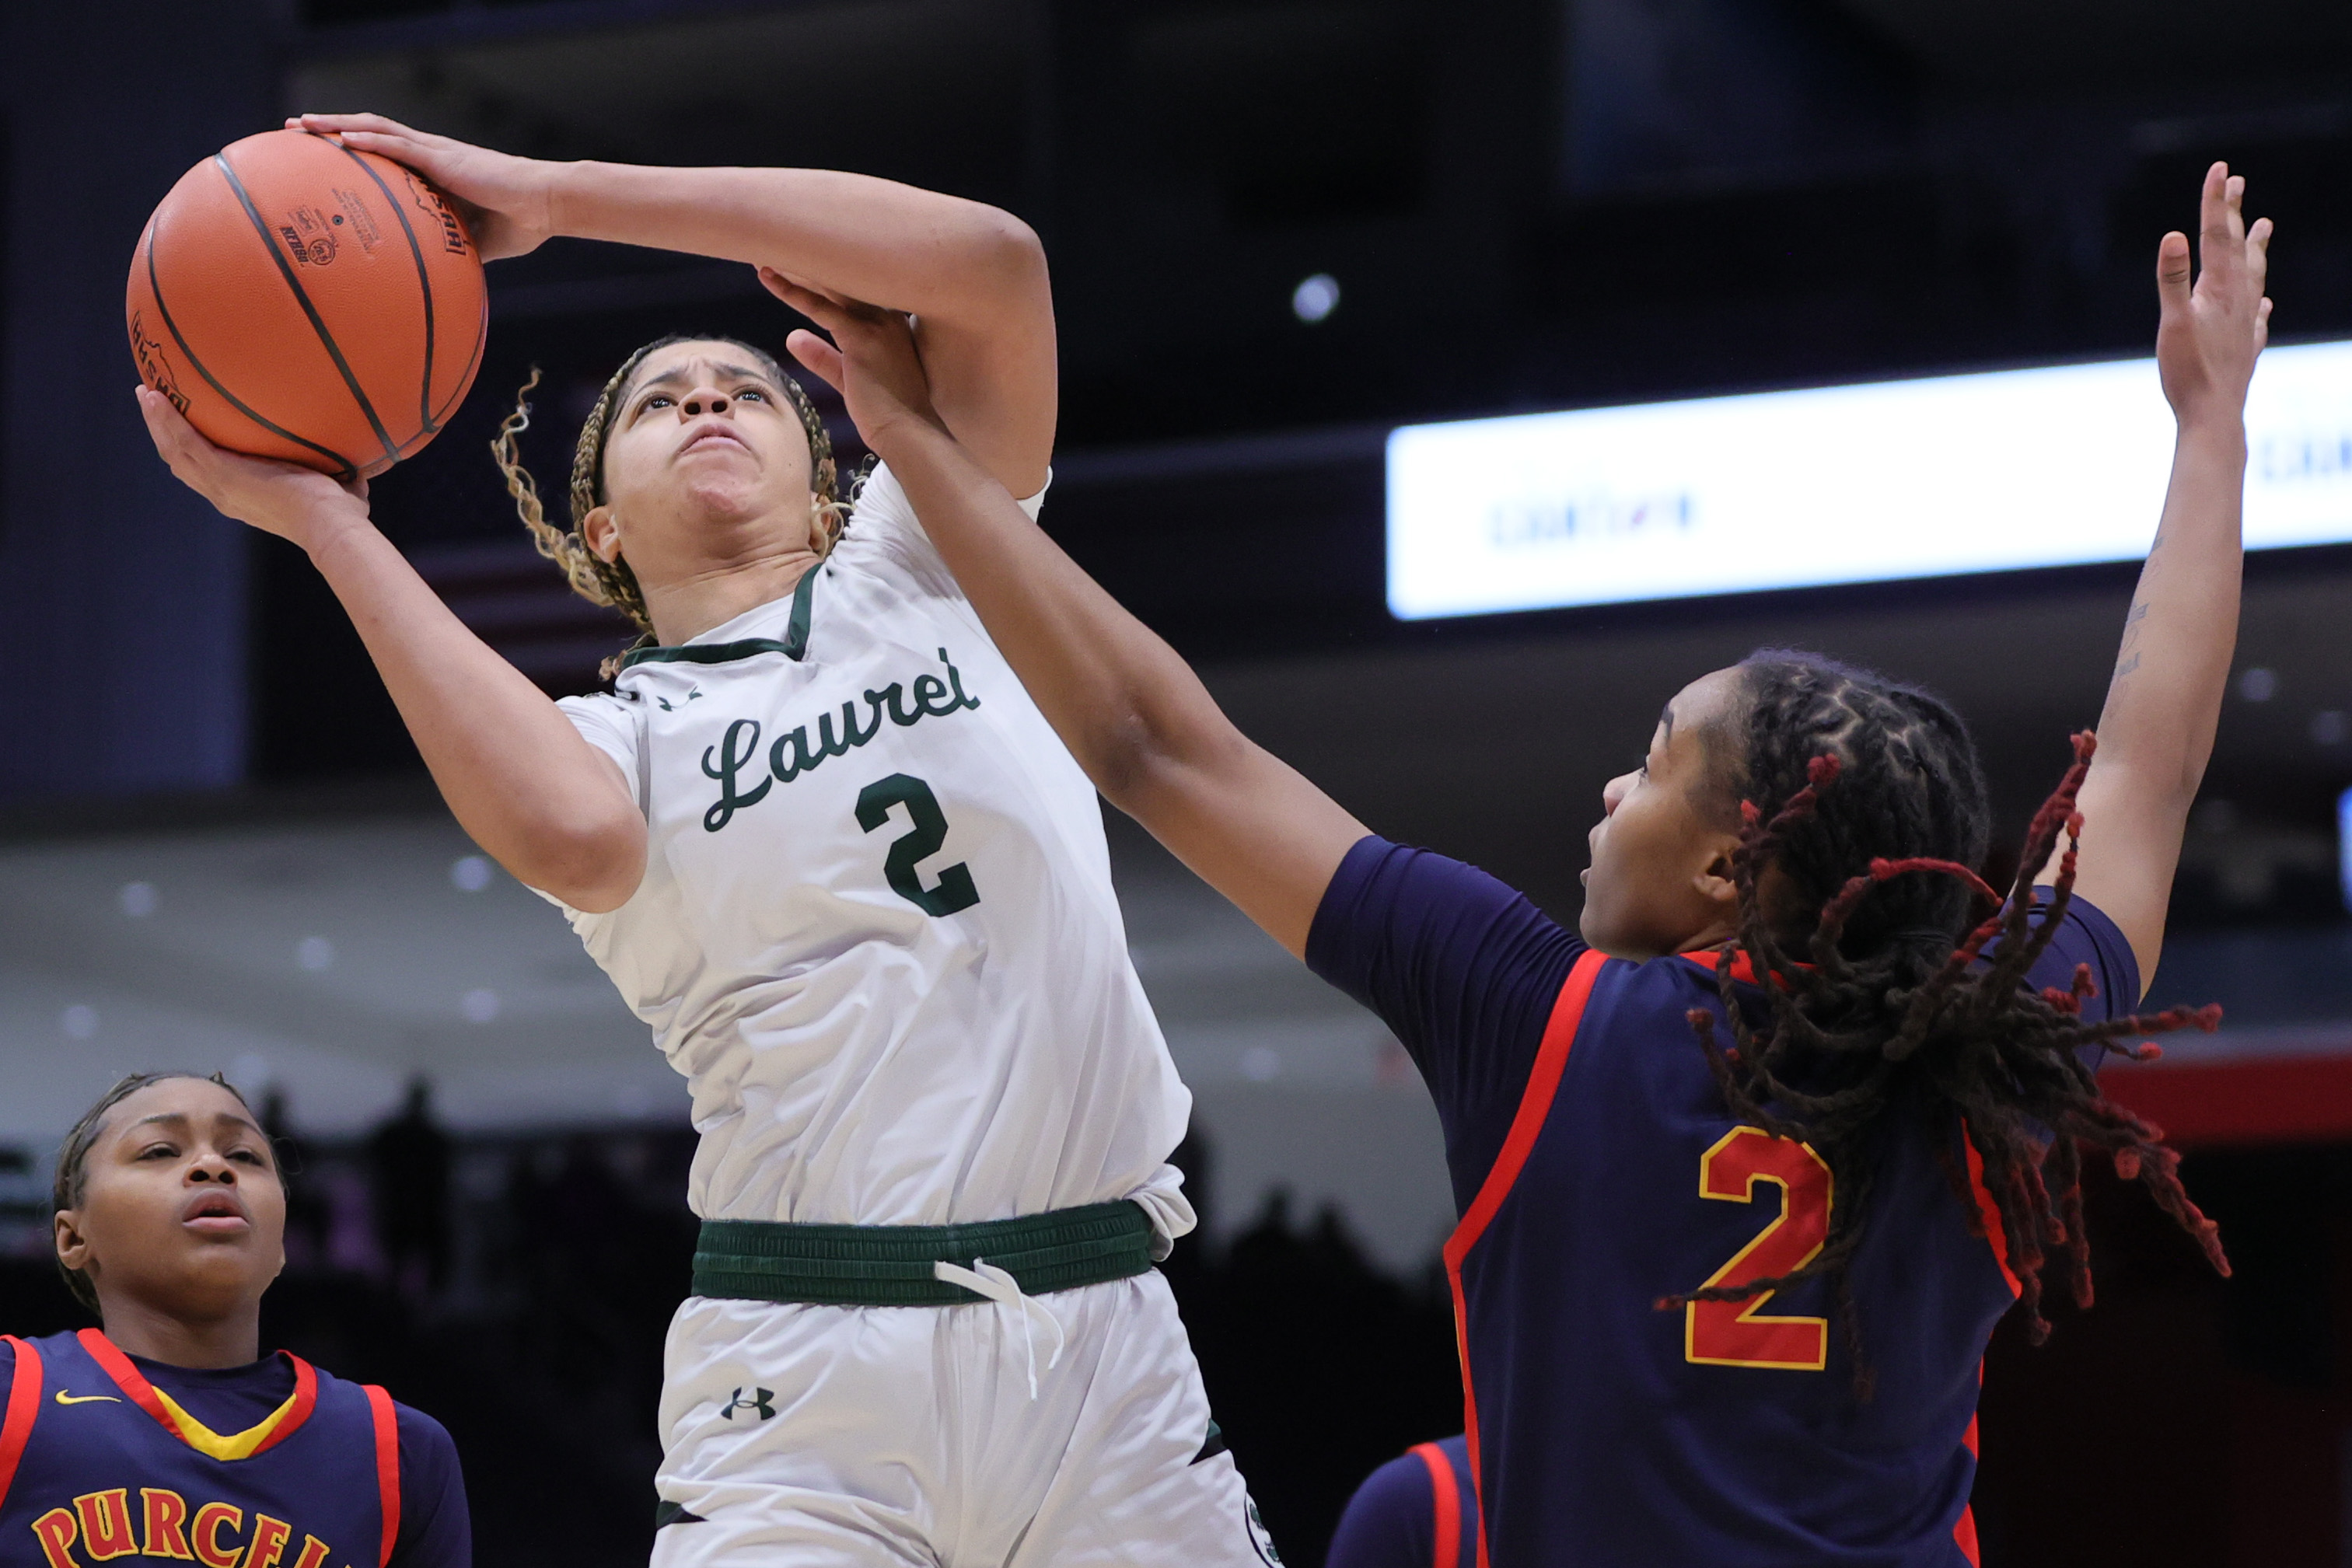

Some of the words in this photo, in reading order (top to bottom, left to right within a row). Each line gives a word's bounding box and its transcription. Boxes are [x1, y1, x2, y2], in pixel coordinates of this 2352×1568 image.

[701, 647, 981, 833] Laurel
[854, 773, 980, 917] 2
[1685, 1125, 1834, 1371] 2
[31, 1487, 352, 1568] PURCE
